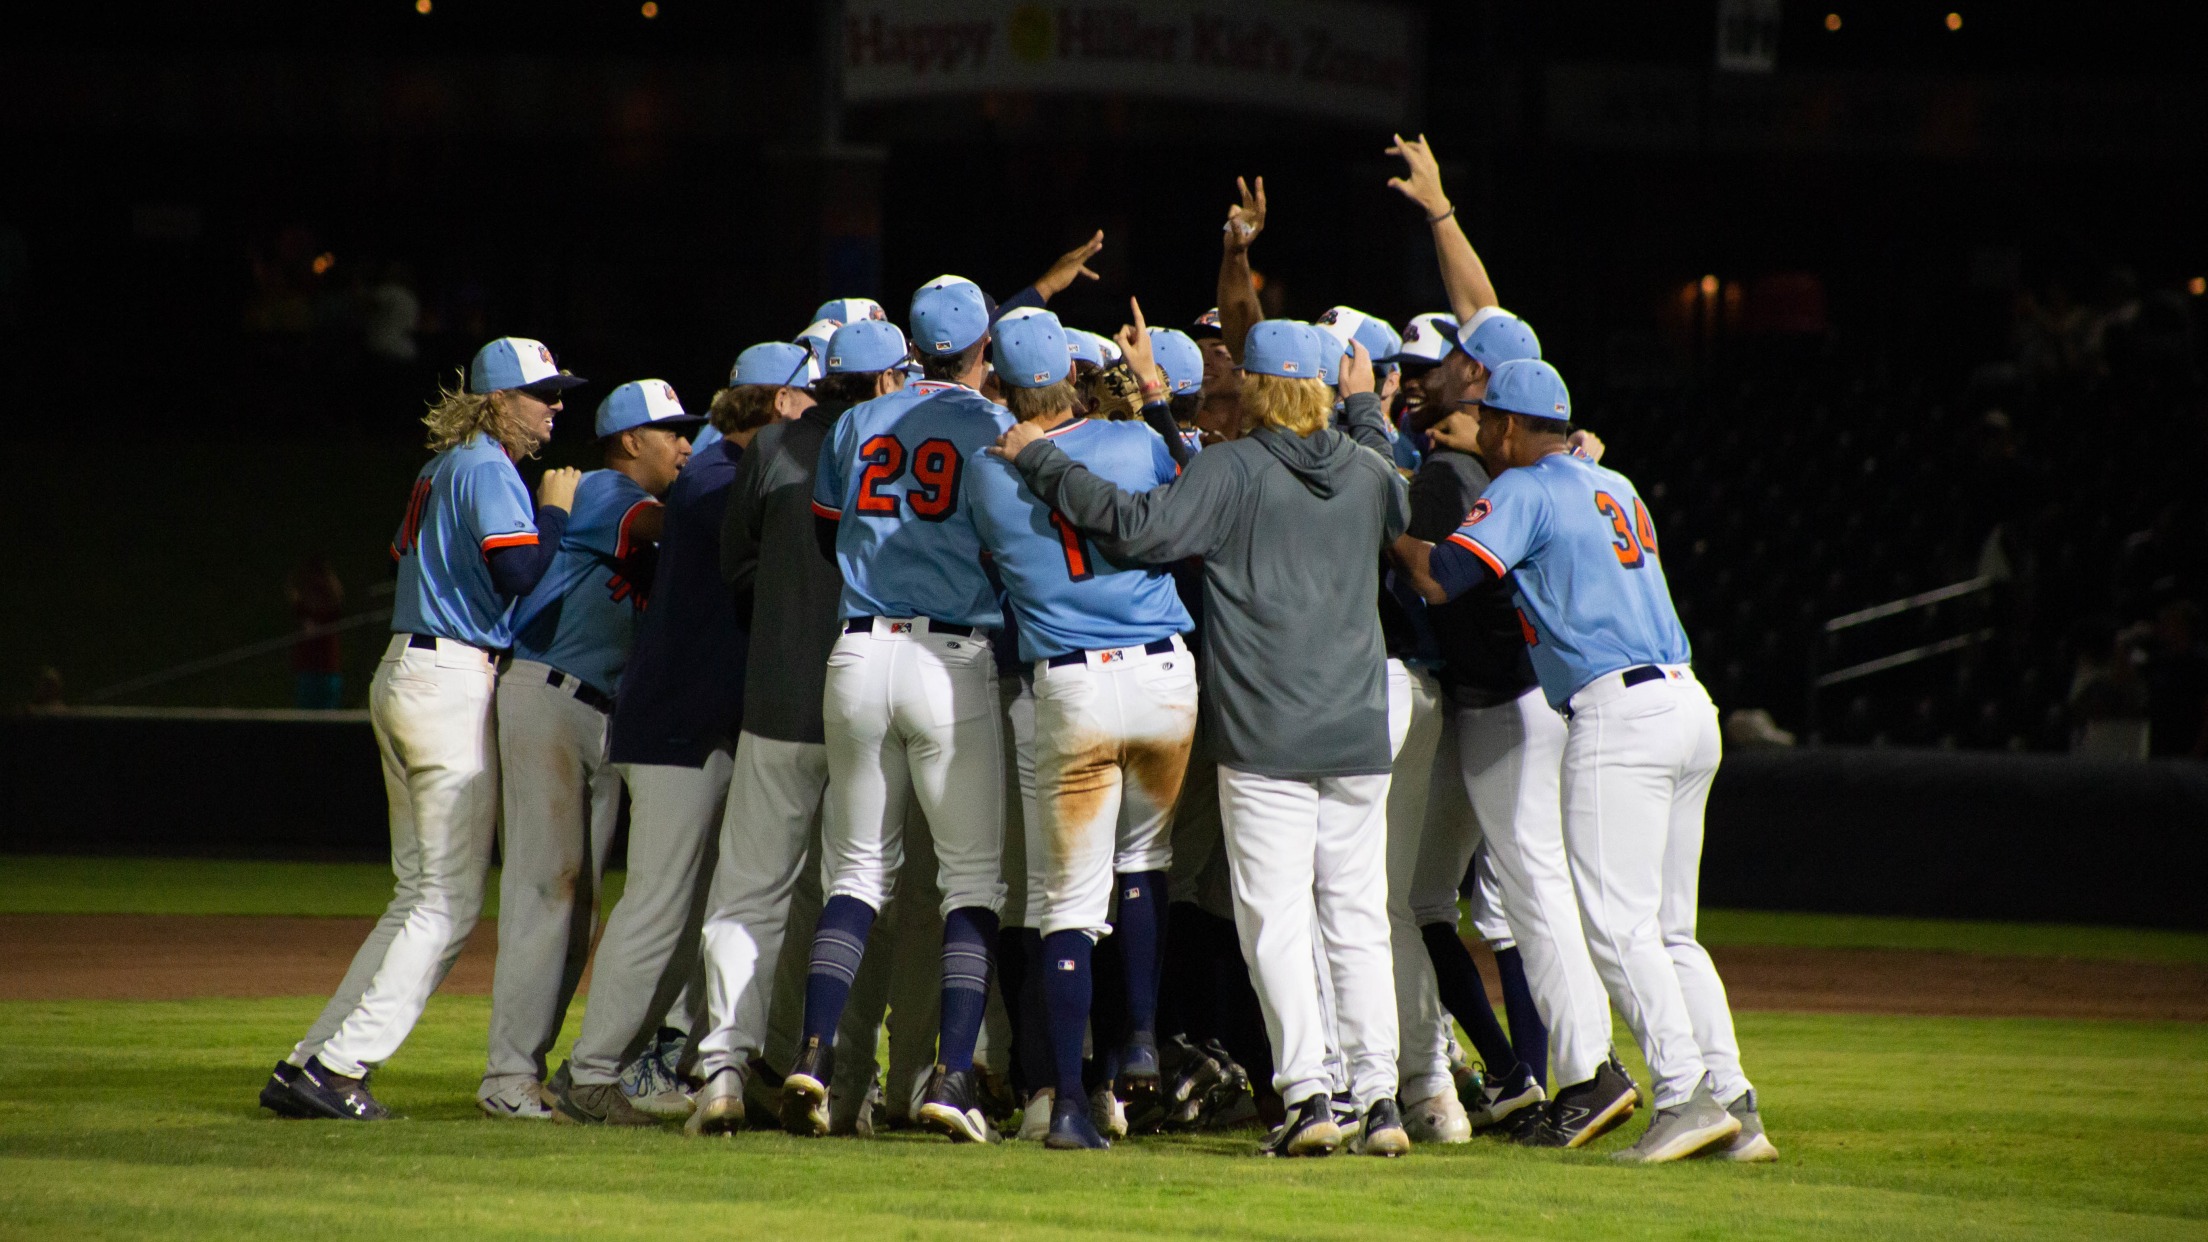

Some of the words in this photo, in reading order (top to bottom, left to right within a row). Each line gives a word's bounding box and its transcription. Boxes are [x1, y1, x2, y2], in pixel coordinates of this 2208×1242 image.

[844, 14, 995, 74] Happy
[855, 434, 964, 523] 29
[1594, 489, 1659, 570] 34
